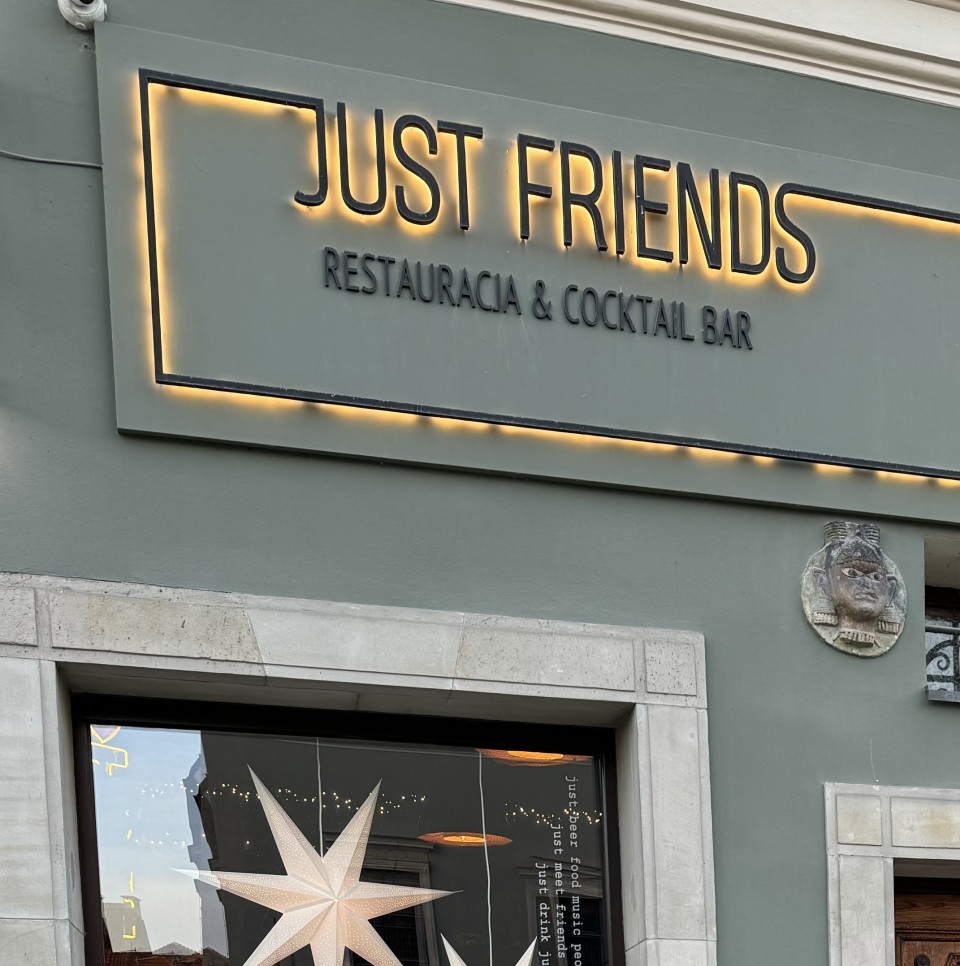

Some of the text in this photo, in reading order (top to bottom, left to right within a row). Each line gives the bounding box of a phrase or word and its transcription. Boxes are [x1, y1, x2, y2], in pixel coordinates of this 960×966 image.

[294, 98, 816, 284] JUST FRIENDS
[323, 246, 753, 351] RESTAURACJA & COCKTAIL BAR
[565, 775, 578, 807] just
[550, 824, 563, 855] just
[569, 815, 580, 847] beer
[535, 862, 548, 894] just
[555, 862, 565, 895] meet
[570, 856, 582, 888] food
[539, 902, 551, 942] drink
[556, 904, 568, 958] friends
[571, 896, 583, 936] music
